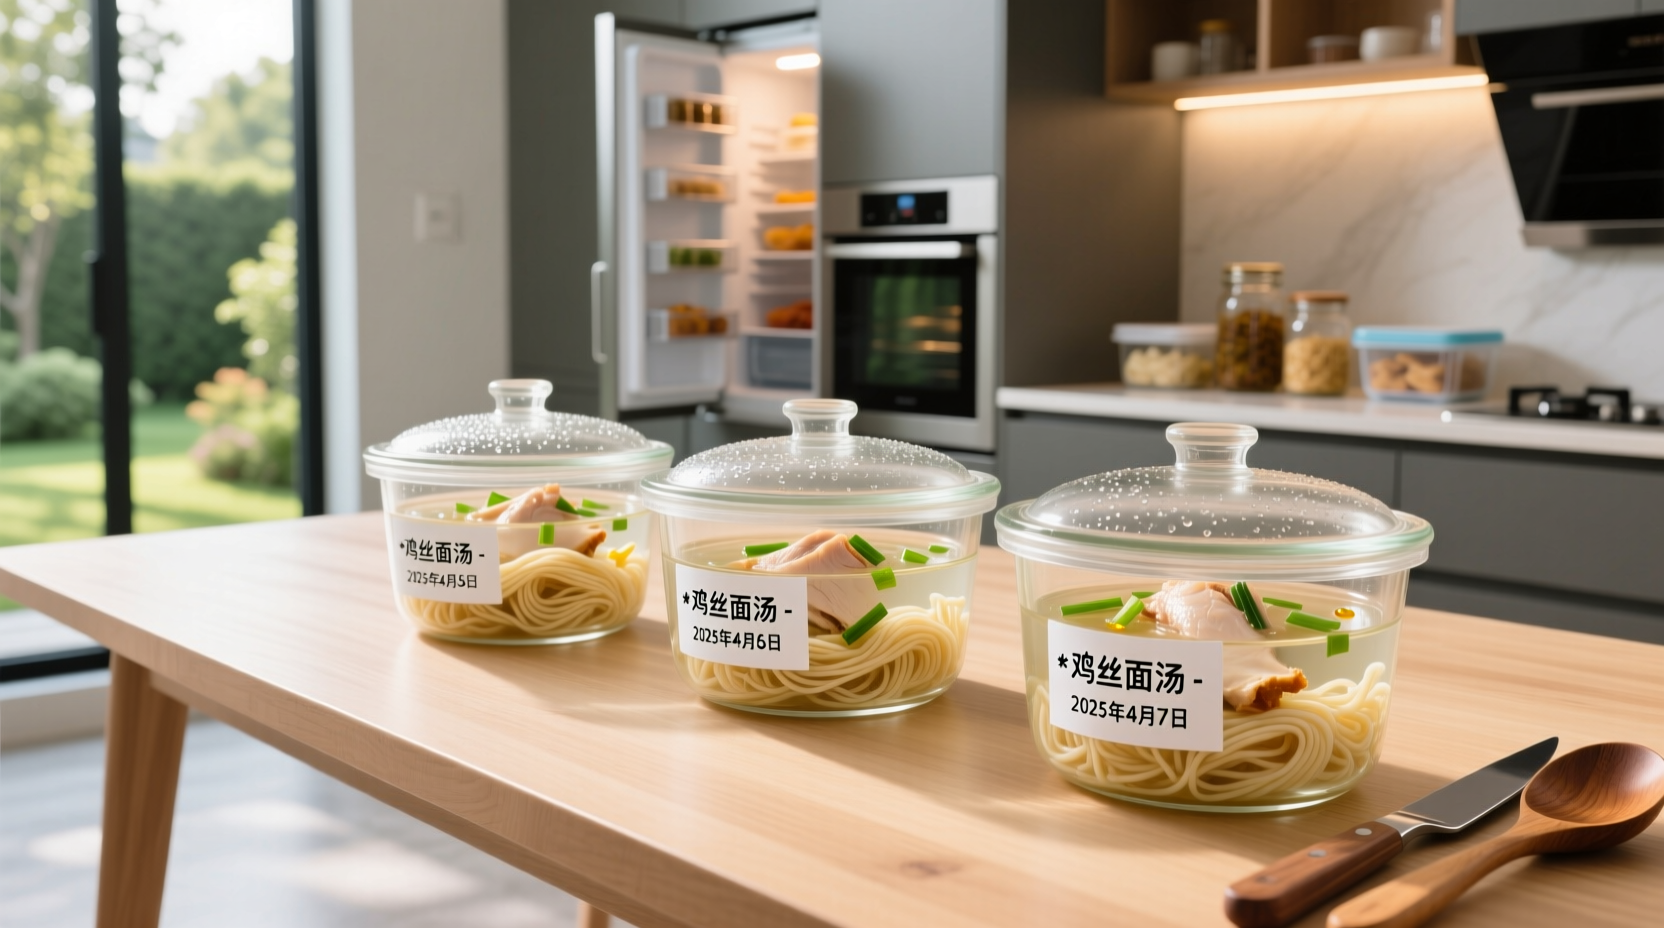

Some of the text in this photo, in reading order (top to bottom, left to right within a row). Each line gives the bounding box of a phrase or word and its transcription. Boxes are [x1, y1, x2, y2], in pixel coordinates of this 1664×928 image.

[693, 625, 781, 652] 2025年4月6日
[1071, 694, 1187, 730] 2025年4月7日
